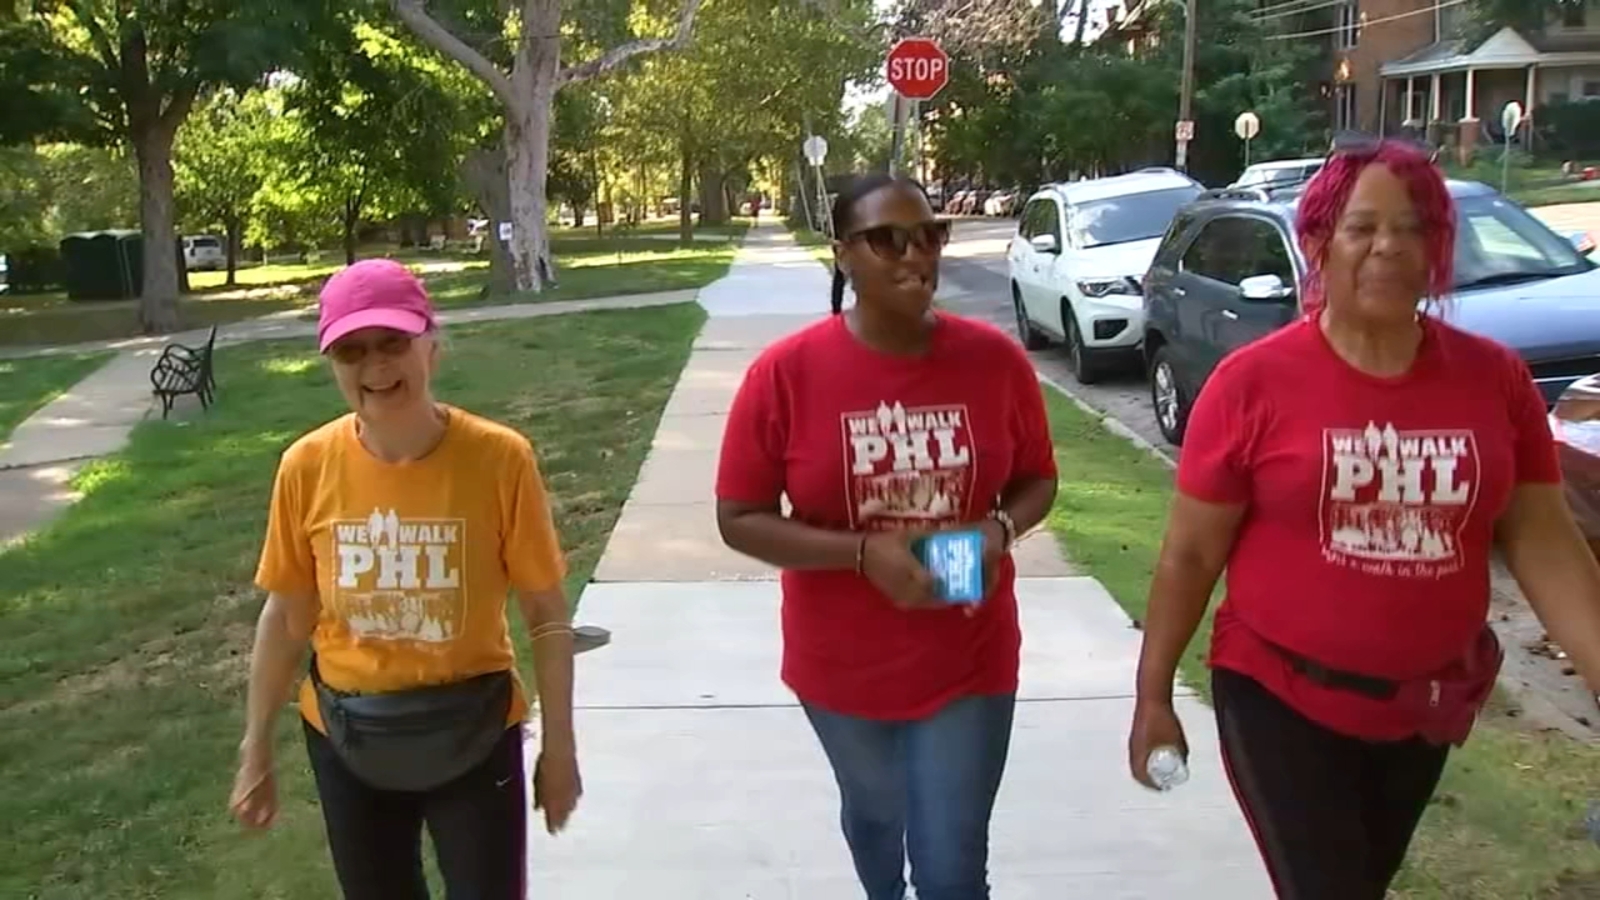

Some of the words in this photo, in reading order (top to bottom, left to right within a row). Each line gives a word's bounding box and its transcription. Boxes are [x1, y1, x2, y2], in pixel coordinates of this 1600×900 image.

[890, 57, 944, 81] STOP
[849, 416, 879, 435] WE
[907, 410, 962, 431] WALK
[850, 428, 970, 476] PHL
[1332, 436, 1368, 453] WE
[1400, 436, 1468, 457] WALK
[1330, 452, 1470, 506] PHL
[337, 524, 369, 543] WE
[400, 524, 458, 543] WALK
[337, 544, 460, 589] PHL
[1361, 560, 1394, 576] walk
[1415, 561, 1434, 577] the
